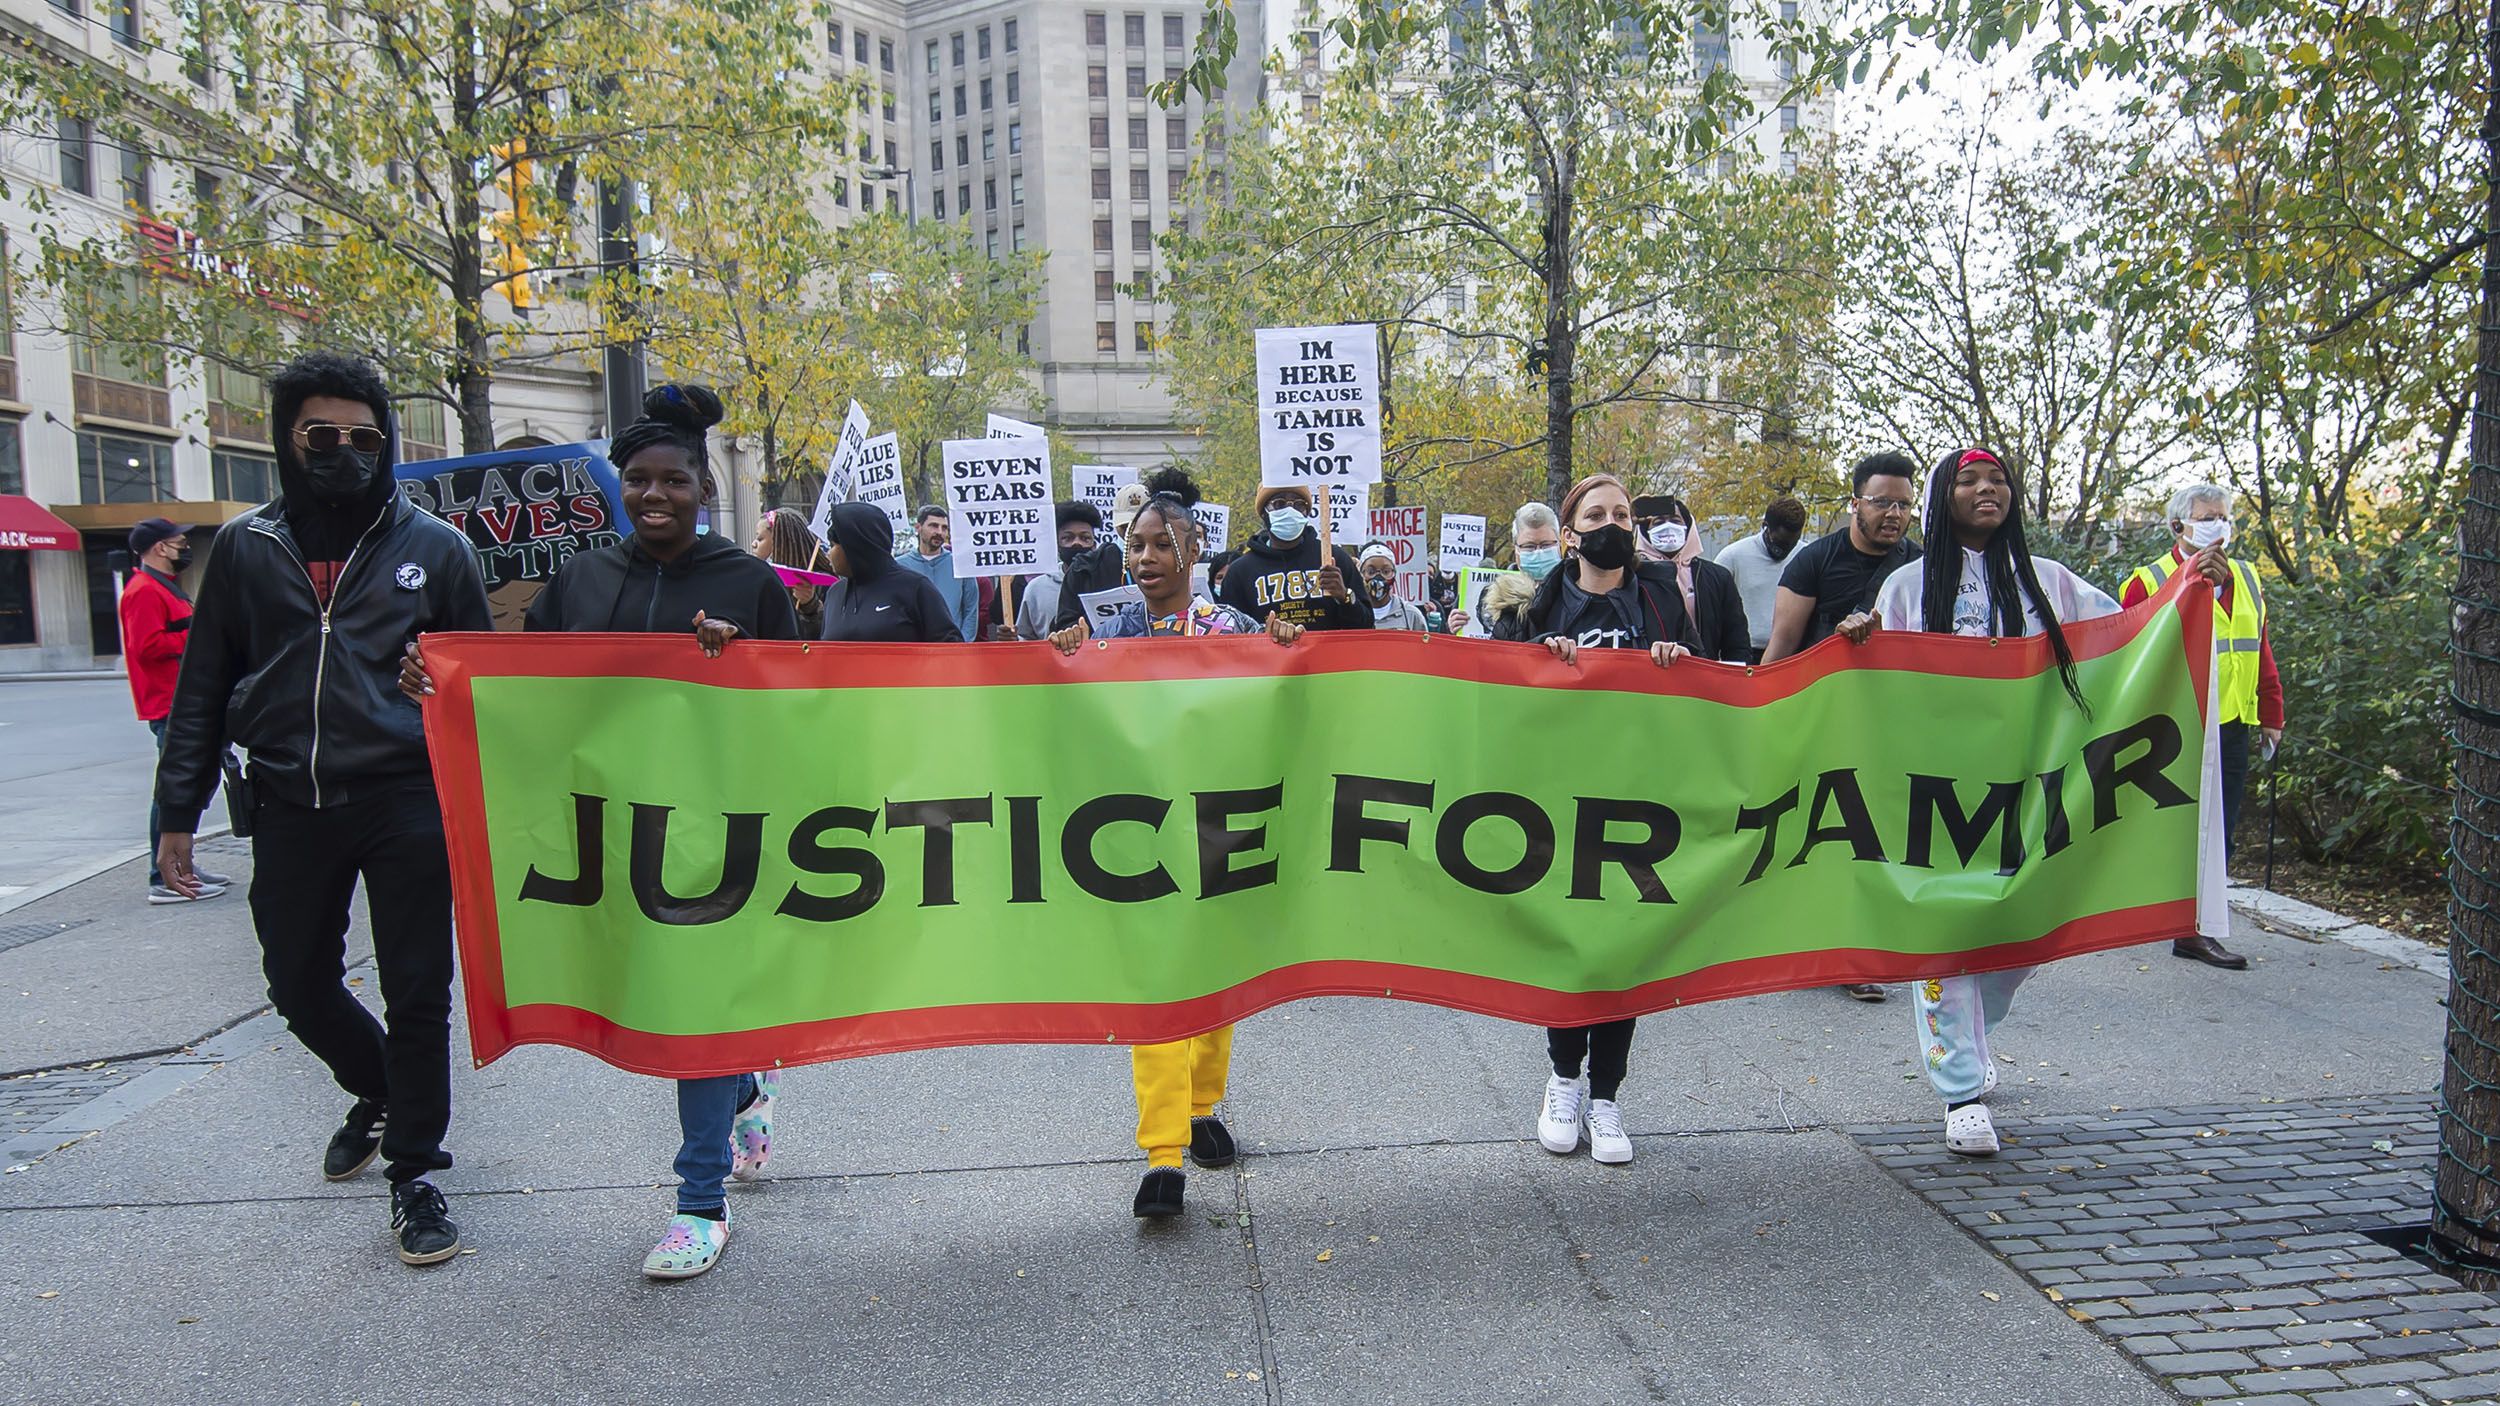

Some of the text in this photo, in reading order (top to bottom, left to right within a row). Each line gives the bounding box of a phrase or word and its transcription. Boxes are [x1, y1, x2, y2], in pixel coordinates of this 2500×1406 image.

[1300, 341, 1334, 360] IM
[1280, 364, 1356, 385] HERE
[1275, 388, 1362, 404] BECAUSE
[1274, 408, 1365, 429] TAMIR
[1306, 432, 1335, 452] IS
[859, 463, 895, 487] LIES
[953, 457, 1041, 478] SEVEN
[1290, 455, 1352, 476] NOT
[1096, 474, 1115, 485] IM
[858, 484, 902, 504] MURDER
[953, 482, 1045, 503] YEARS
[1085, 486, 1121, 498] HER
[1328, 494, 1357, 505] WAS
[448, 495, 605, 545] IVES
[966, 509, 1040, 527] WE'RE
[1309, 507, 1352, 519] OLY
[1366, 507, 1425, 537] HARGE
[1443, 522, 1483, 533] JUSTICE
[973, 529, 1036, 546] STILL
[1457, 533, 1466, 543] 4
[975, 549, 1037, 567] HERE
[1386, 538, 1415, 566] ND
[1442, 544, 1481, 557] TAMIR
[517, 713, 2198, 926] JUSTICE FOR TAMIR
